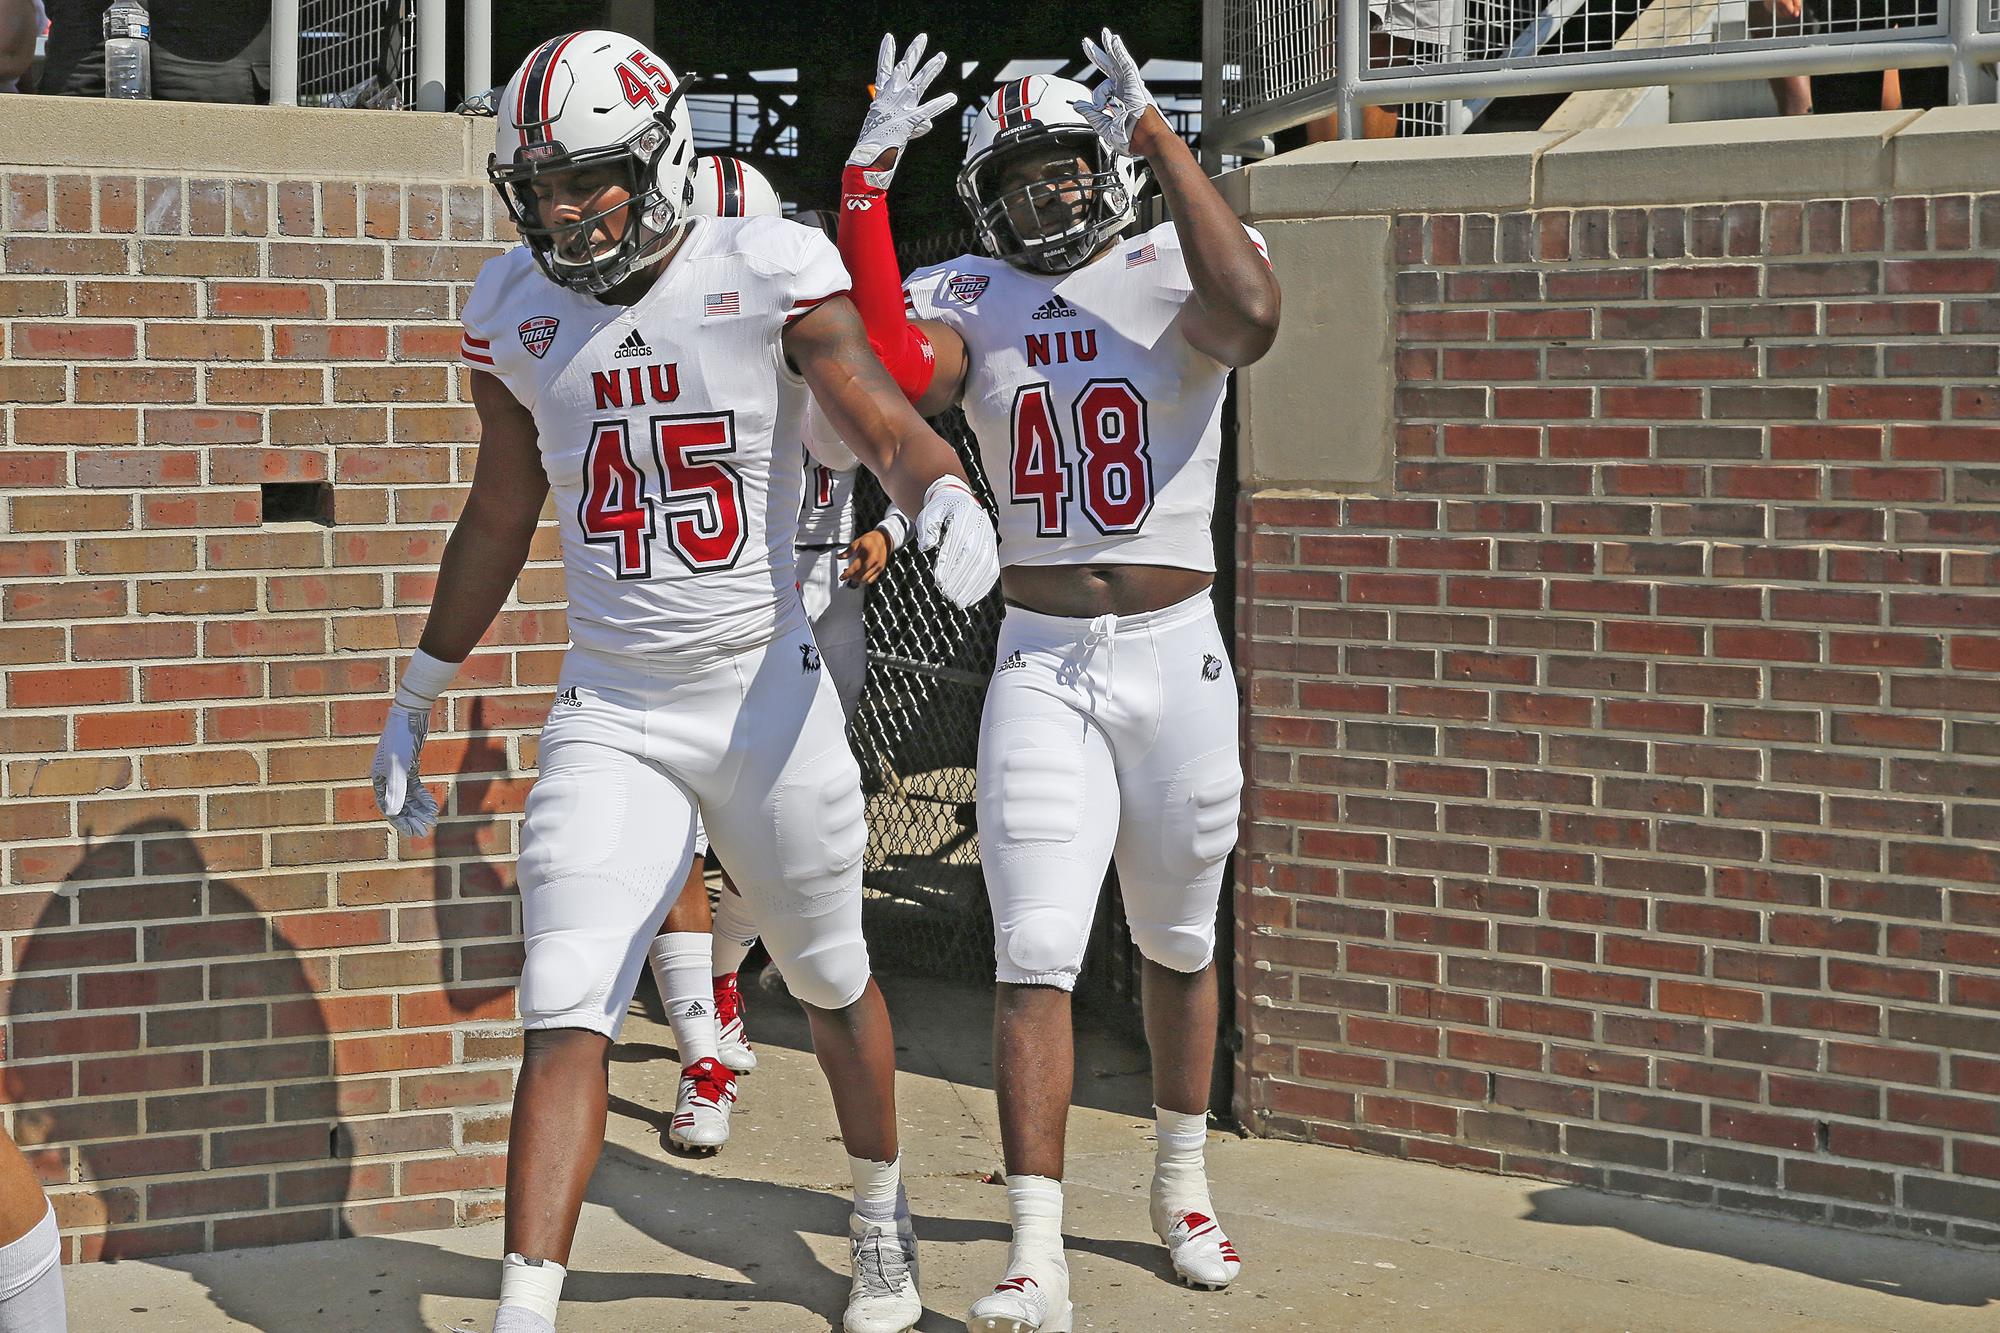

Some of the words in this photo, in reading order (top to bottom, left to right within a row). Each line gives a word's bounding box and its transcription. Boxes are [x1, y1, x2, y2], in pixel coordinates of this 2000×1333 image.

[614, 50, 674, 110] 45
[1001, 124, 1032, 138] HUSKIES
[1032, 307, 1077, 320] adidas
[522, 327, 555, 343] MAC
[614, 346, 652, 359] adidas
[1025, 329, 1098, 367] NIU
[591, 363, 680, 409] NIU
[1010, 378, 1155, 538] 48
[577, 410, 749, 580] 45
